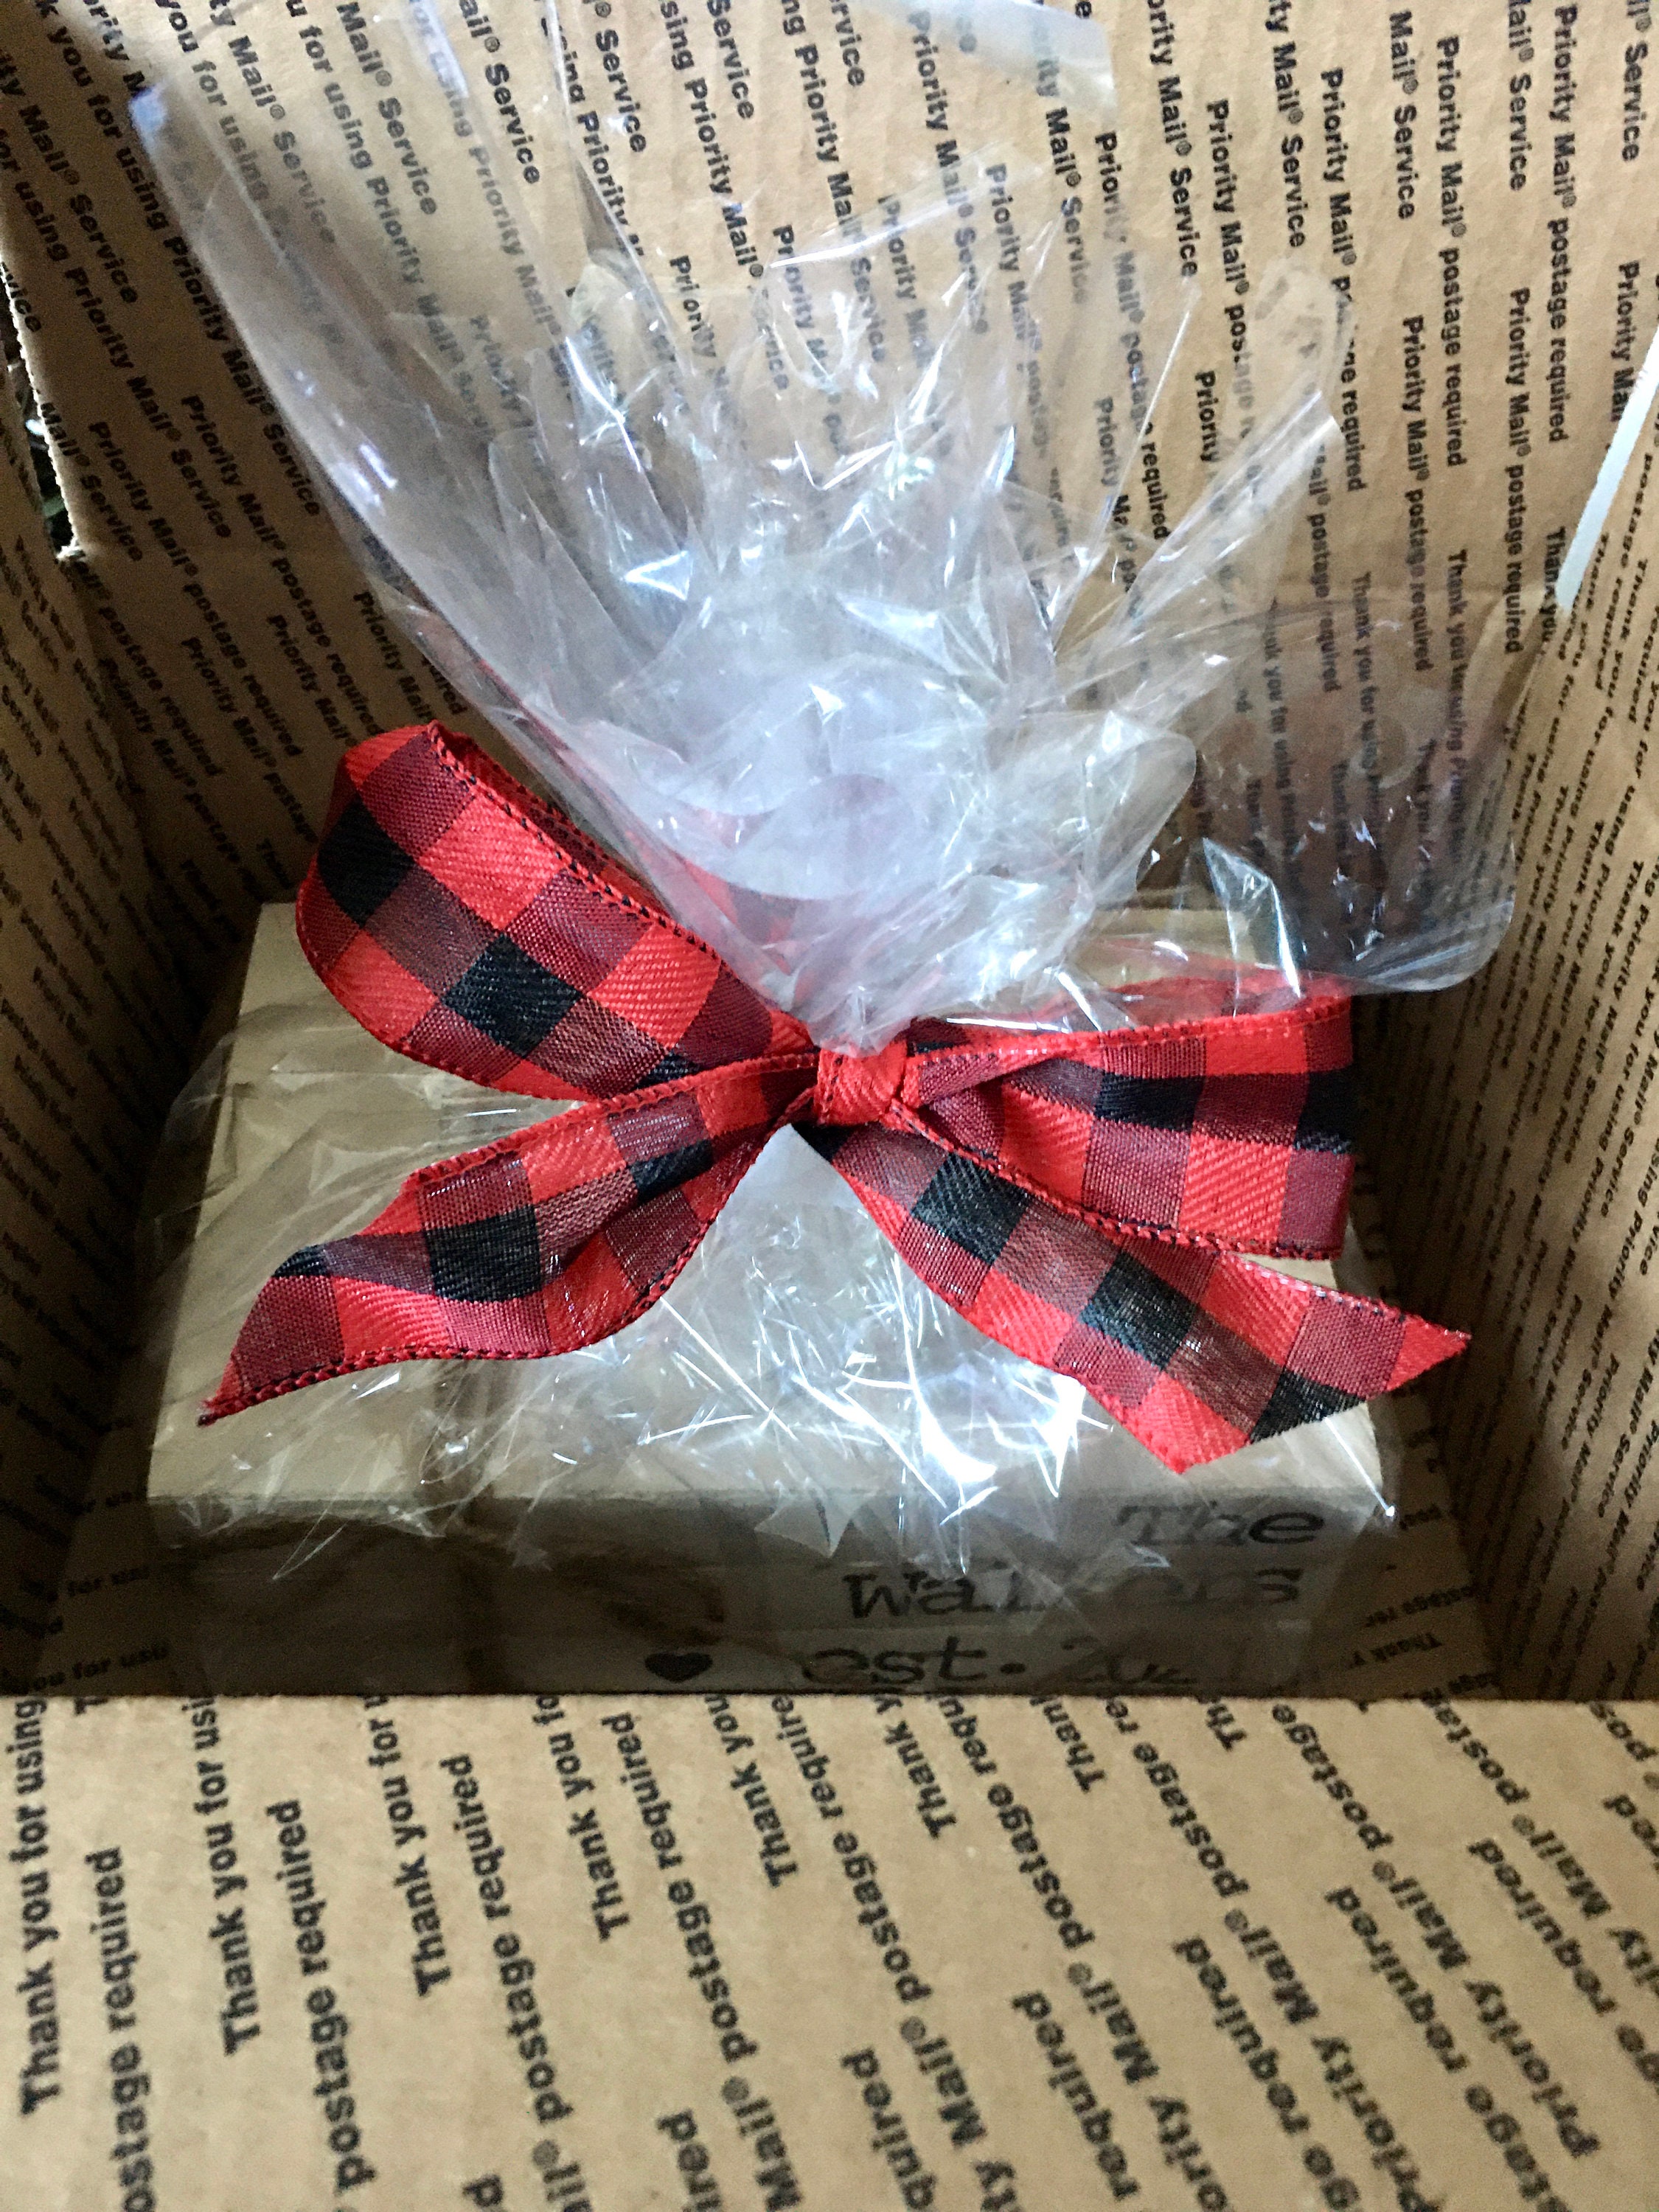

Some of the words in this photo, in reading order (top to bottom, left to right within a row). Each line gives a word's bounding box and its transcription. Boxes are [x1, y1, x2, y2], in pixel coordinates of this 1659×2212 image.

[596, 29, 646, 152] Service
[707, 0, 754, 119] Service
[909, 10, 948, 131] Priority
[1273, 42, 1303, 124] Mail®
[1389, 10, 1419, 94] Mail®
[1436, 36, 1461, 151] Priority
[1549, 4, 1578, 122] Priority
[192, 60, 227, 105] for
[220, 116, 269, 201] using
[485, 63, 539, 184] Service
[684, 78, 732, 194] Priority
[795, 44, 839, 161] Priority
[1321, 69, 1348, 181] Priority
[1509, 74, 1532, 190] Service
[1622, 42, 1648, 161] Service
[299, 26, 333, 72] for
[324, 83, 373, 170] using
[366, 176, 424, 284] Priority
[378, 98, 437, 215] Service
[468, 147, 524, 255] Priority
[1207, 100, 1237, 212] Priority
[1281, 135, 1308, 247] Service
[1394, 105, 1419, 219] Service
[1441, 162, 1466, 237] Mail®
[1554, 133, 1576, 208] Mail®
[69, 195, 138, 304] Service
[986, 164, 1020, 271] Priority
[1170, 167, 1200, 275] Service
[1220, 221, 1249, 295] Mail®
[1330, 192, 1356, 265] Mail®
[46, 27, 94, 87] you
[87, 94, 122, 139] for
[116, 147, 169, 231] using
[163, 236, 229, 341] Priority
[263, 424, 320, 515] Service
[1439, 248, 1463, 355] postage
[1547, 218, 1571, 330] postage
[1610, 262, 1639, 361] Priority
[14, 181, 70, 262] using
[63, 267, 134, 368] Priority
[170, 449, 231, 538] Service
[1402, 316, 1425, 411] Priority
[1506, 288, 1530, 386] Priority
[1442, 364, 1467, 466] required
[1509, 392, 1531, 456] Mail®
[1546, 338, 1570, 442] required
[1340, 390, 1366, 492] required
[80, 475, 142, 561] Service
[181, 394, 243, 485] Priority
[271, 557, 330, 647] postage
[1141, 442, 1171, 540] required
[1405, 489, 1428, 576] postage
[1505, 465, 1526, 566] postage
[1621, 453, 1653, 568] postage
[88, 422, 153, 511] Priority
[183, 583, 247, 669] postage
[241, 674, 303, 757] required
[1307, 513, 1330, 598] postage
[1448, 549, 1467, 614] Thank
[1586, 534, 1609, 611] Thank
[1621, 560, 1647, 640] Thank
[266, 615, 321, 692] Priority
[353, 591, 404, 670] Priority
[1410, 583, 1433, 672] required
[1503, 566, 1525, 654] required
[1572, 622, 1587, 667] you
[1595, 577, 1622, 690] required
[181, 637, 237, 713] Priority
[1353, 639, 1372, 682] you
[1558, 675, 1574, 710] for
[1607, 650, 1622, 698] you
[1644, 682, 1659, 731] you
[159, 696, 226, 777] required
[1594, 707, 1613, 744] for
[1635, 740, 1648, 779] for
[1543, 787, 1568, 855] Thank
[1571, 750, 1595, 818] using
[1605, 786, 1635, 855] using
[1543, 826, 1574, 914] Priority
[1576, 821, 1604, 894] Thank
[1613, 861, 1644, 936] Thank
[1562, 902, 1578, 946] you
[1576, 863, 1610, 956] Priority
[1613, 905, 1649, 1000] Priority
[1585, 996, 1599, 1032] for
[1596, 942, 1614, 988] you
[1635, 987, 1655, 1037] you
[1624, 1043, 1638, 1080] for
[1634, 1054, 1658, 1125] Mail®
[1564, 1077, 1596, 1164] Service
[1599, 1085, 1624, 1151] using
[1572, 1157, 1604, 1242] Priority
[1601, 1127, 1634, 1217] Service
[1609, 1211, 1643, 1300] Priority
[1587, 1354, 1619, 1438] Priority
[1624, 1420, 1659, 1509] Priority
[7, 1700, 46, 1795] using
[194, 1761, 228, 1815] for
[368, 1719, 401, 1767] for
[549, 1733, 595, 1799] you
[601, 1713, 683, 1870] required
[885, 1721, 956, 1839] Thank
[1272, 1705, 1393, 1851] postage
[10, 1806, 48, 1863] for
[383, 1775, 426, 1846] you
[440, 1755, 510, 1920] required
[731, 1762, 798, 1887] Thank
[1133, 1744, 1249, 1898] postage
[206, 1823, 247, 1899] you
[266, 1801, 328, 1976] required
[568, 1809, 629, 1941] Thank
[988, 1784, 1095, 1949] postage
[21, 1871, 59, 1952] you
[85, 1848, 139, 2031] required
[394, 1855, 451, 1997] Thank
[833, 1832, 932, 2003] postage
[1468, 1840, 1616, 2014] required
[209, 1907, 260, 2055] Thank
[668, 1880, 757, 2063] postage
[1324, 1888, 1467, 2072] required
[17, 1961, 60, 2115] Thank
[493, 1934, 574, 2124] postage
[1173, 1938, 1310, 2135] required
[1465, 1983, 1600, 2159] Priority
[307, 1988, 376, 2194] postage
[1012, 1992, 1140, 2202] required
